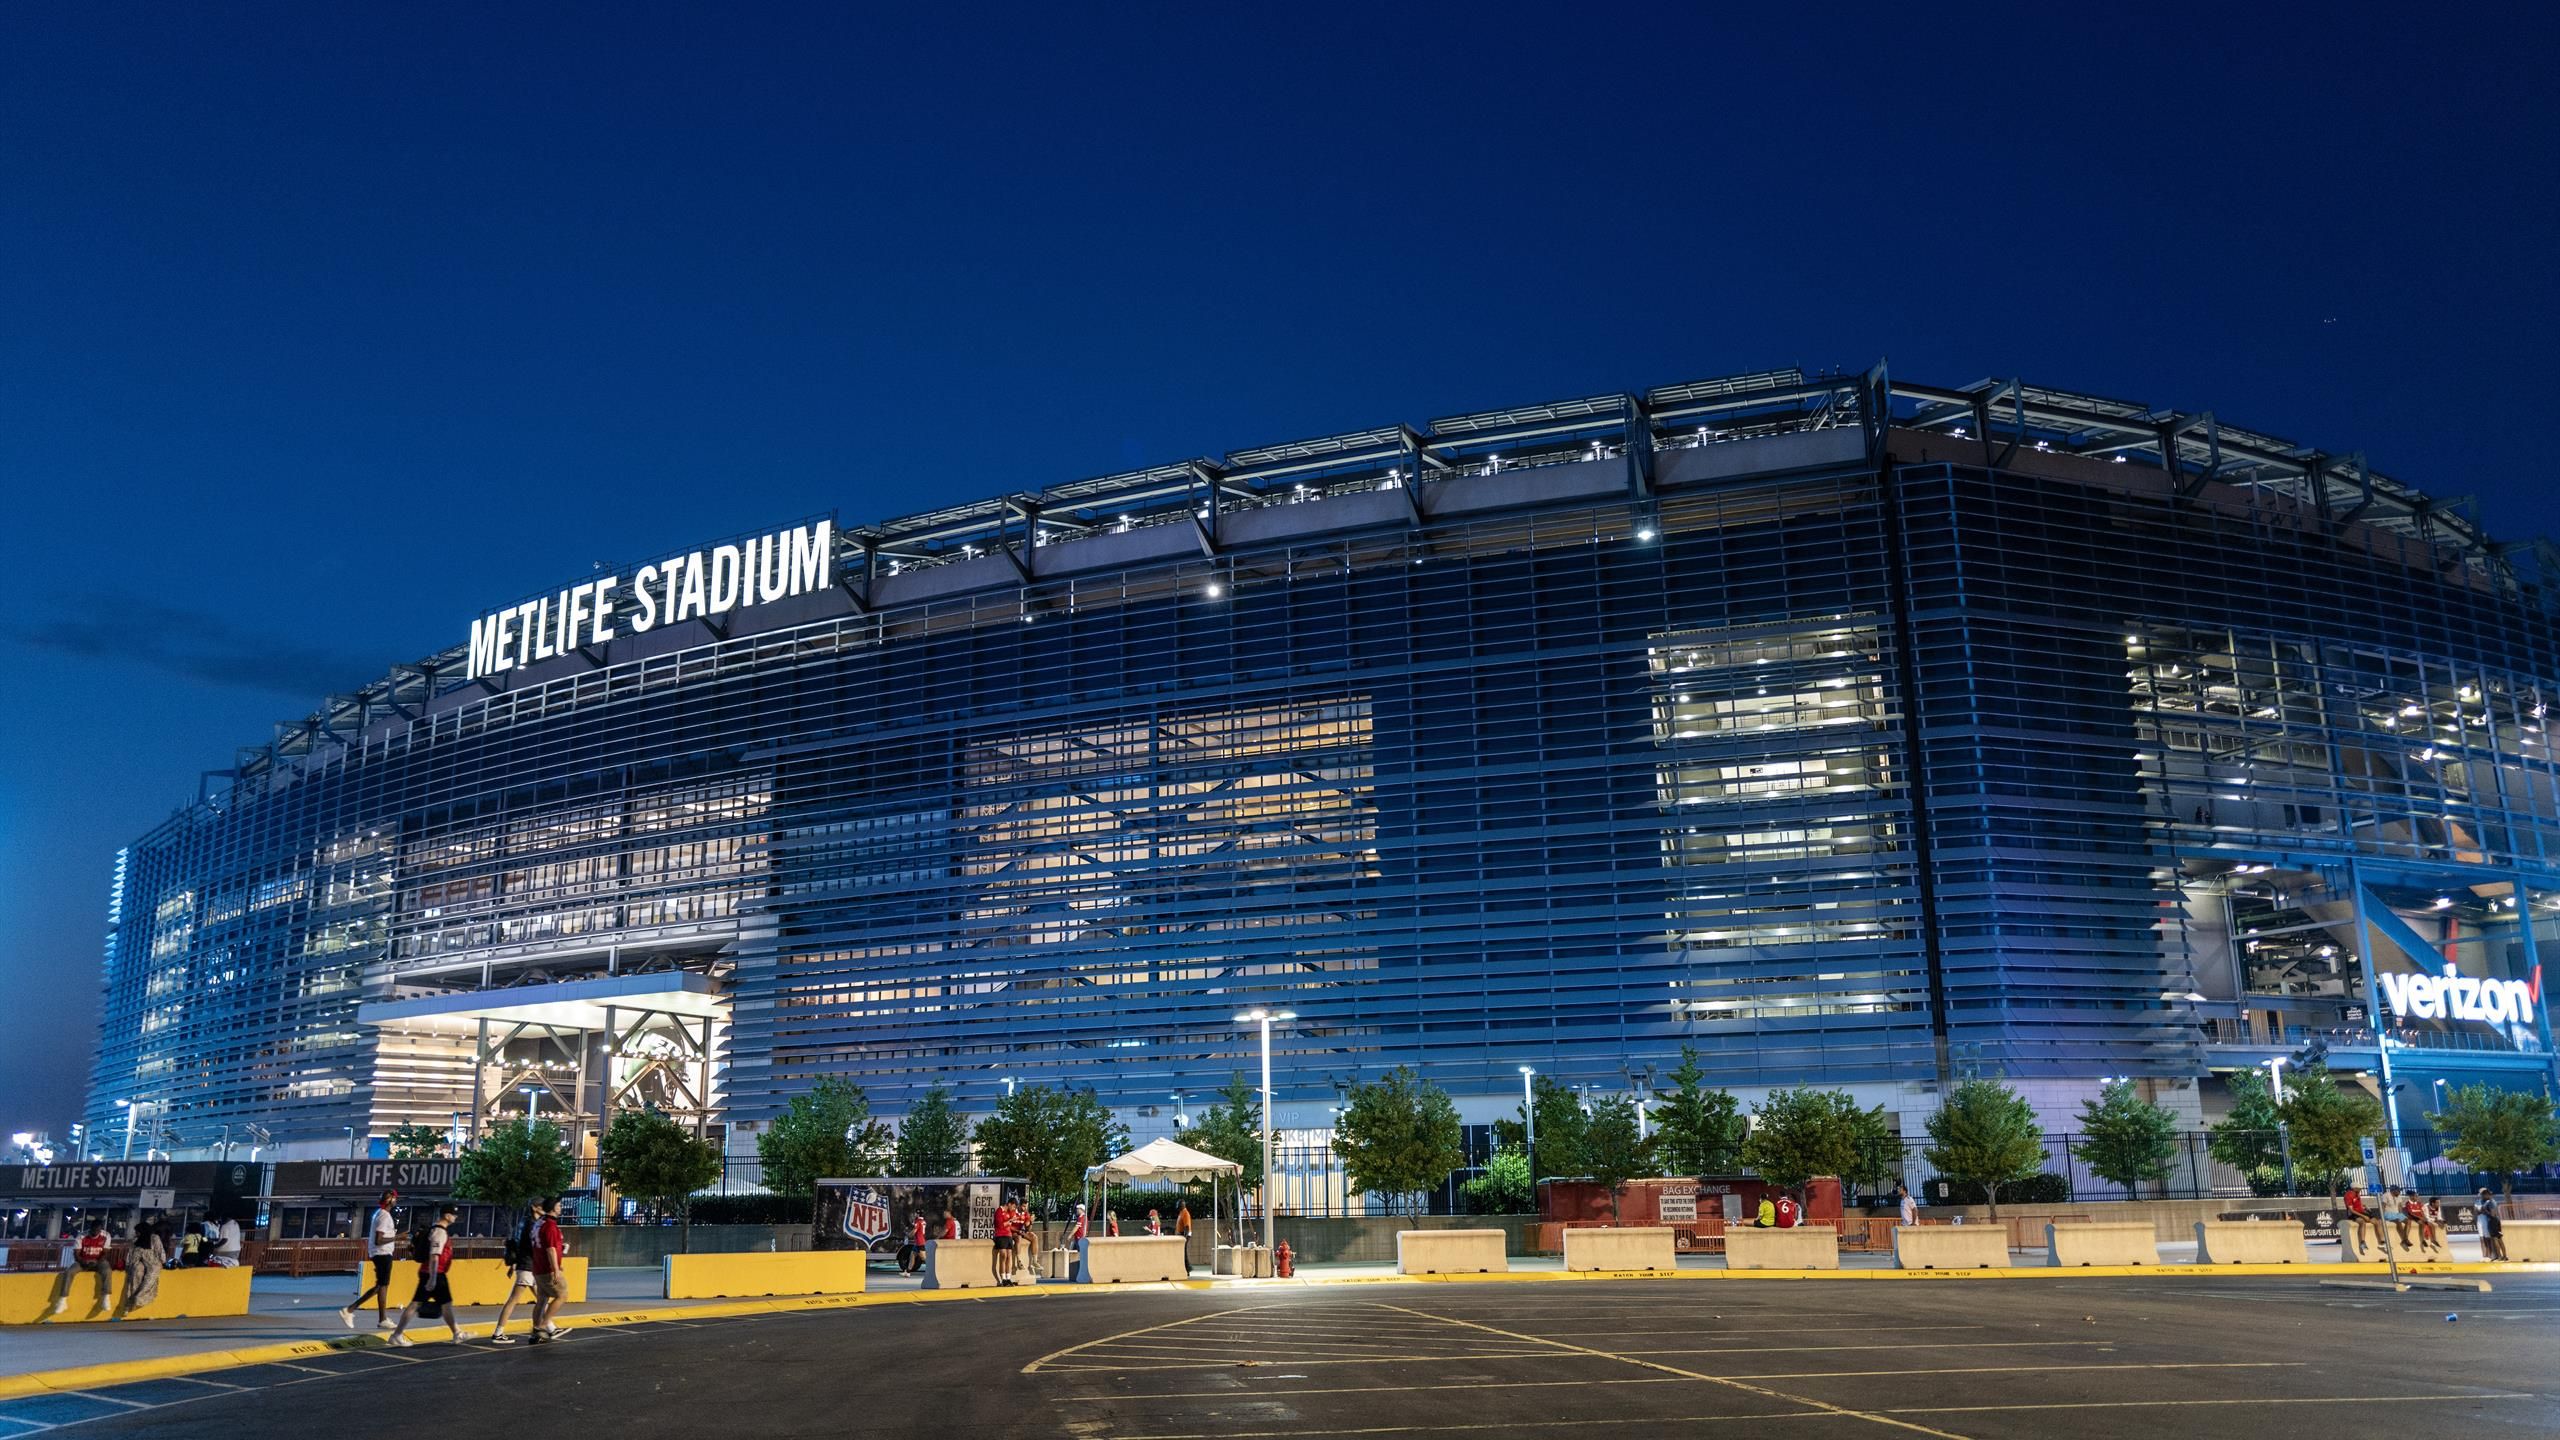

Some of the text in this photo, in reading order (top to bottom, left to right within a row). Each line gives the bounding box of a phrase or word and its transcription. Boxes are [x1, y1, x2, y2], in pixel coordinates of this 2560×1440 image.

[467, 520, 831, 680] METLIFE STADIUM
[2380, 963, 2534, 1024] verizon
[1279, 1111, 1300, 1123] VIP
[21, 1165, 171, 1189] METLIFE STADIUM
[320, 1163, 461, 1186] METLIFE STADIU
[1663, 1185, 1731, 1195] BAG EXCHANGE
[975, 1197, 992, 1206] GET
[1782, 1203, 1789, 1213] 6
[851, 1203, 888, 1235] NFL
[290, 1345, 318, 1354] WATCH
